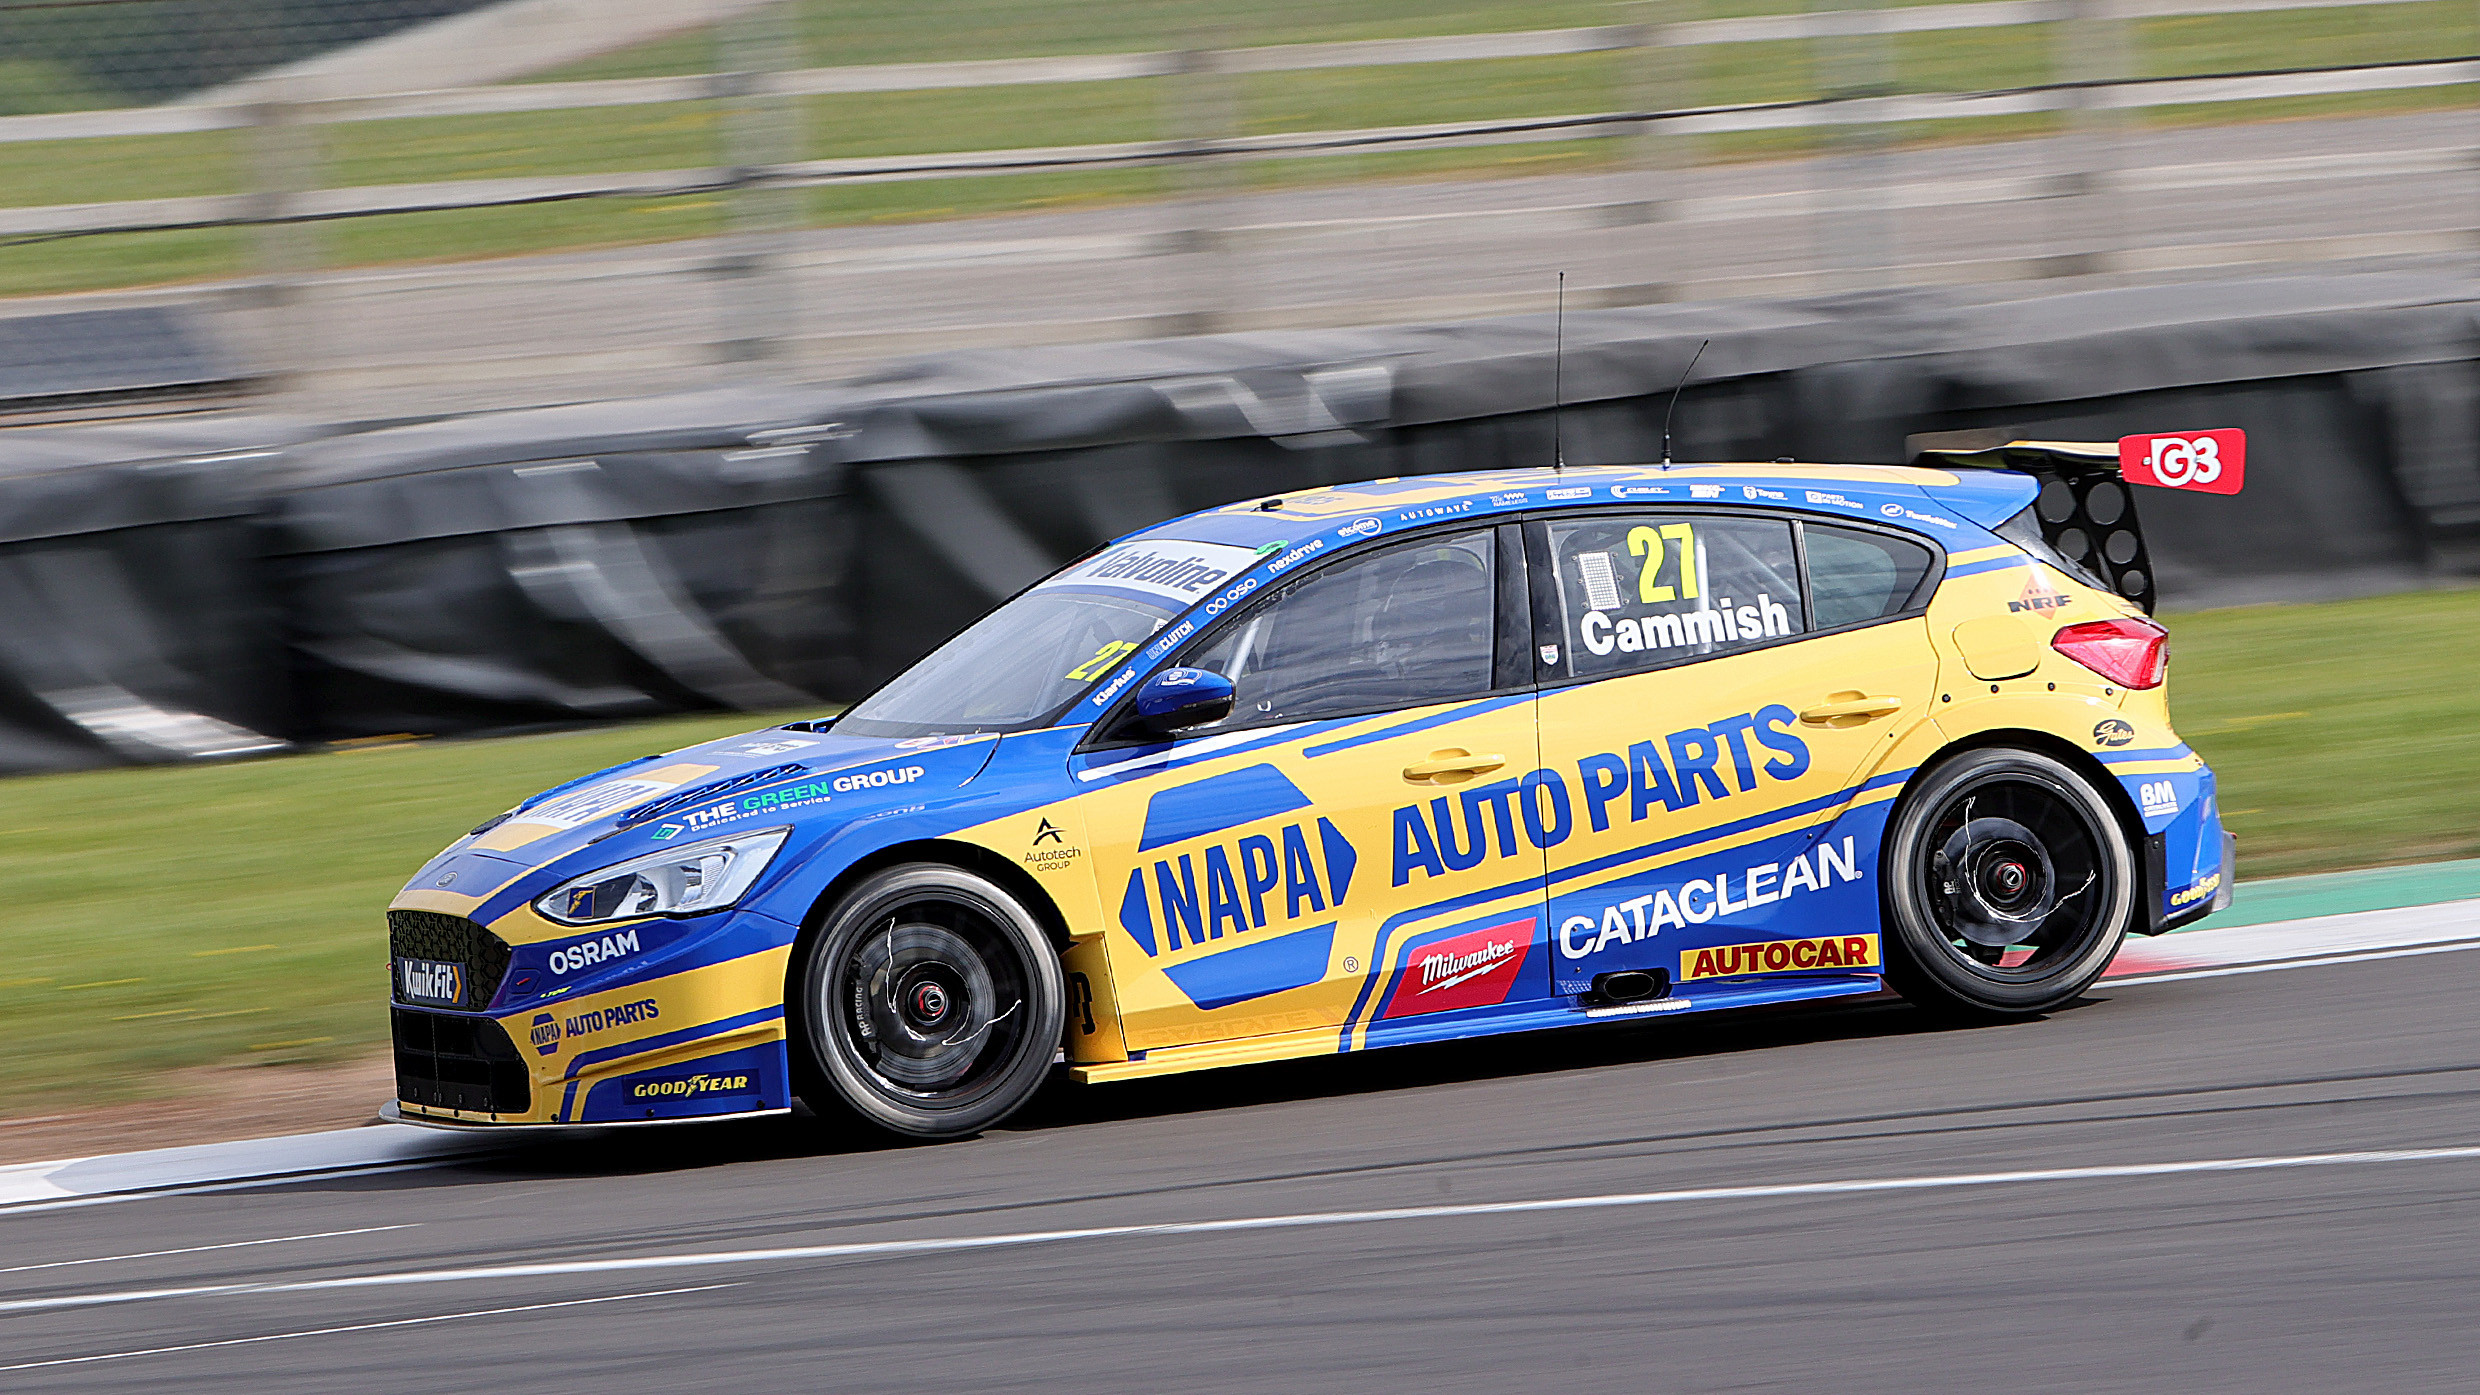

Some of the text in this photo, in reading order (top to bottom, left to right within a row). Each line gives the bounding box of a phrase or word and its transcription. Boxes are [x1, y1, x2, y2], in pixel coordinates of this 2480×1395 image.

[2150, 436, 2222, 487] G3
[1400, 503, 1471, 521] AUTOWAVE
[1086, 551, 1228, 592] Valvoline
[1267, 539, 1323, 574] nexdrive
[1626, 522, 1700, 604] 27
[1580, 593, 1791, 656] Cammish
[2007, 595, 2073, 613] NRF
[1064, 640, 1139, 683] 27
[1092, 669, 1136, 706] Klarius
[2094, 721, 2135, 746] Gates
[683, 766, 925, 826] THE GREEN GROUP
[1392, 704, 1811, 887] AUTO PARTS
[2140, 780, 2177, 806] BM
[691, 796, 832, 832] Dedicated to Service
[1024, 846, 1081, 863] Autotech
[1037, 861, 1071, 872] GROUP
[1154, 823, 1326, 952] NAPA
[549, 929, 640, 975] OSRAM
[1417, 940, 1515, 985] Milwaukee
[1691, 937, 1869, 978] AUTOCAR
[533, 999, 659, 1045] NAPA AUTO PARTS
[634, 1075, 748, 1097] GOODYEAR
